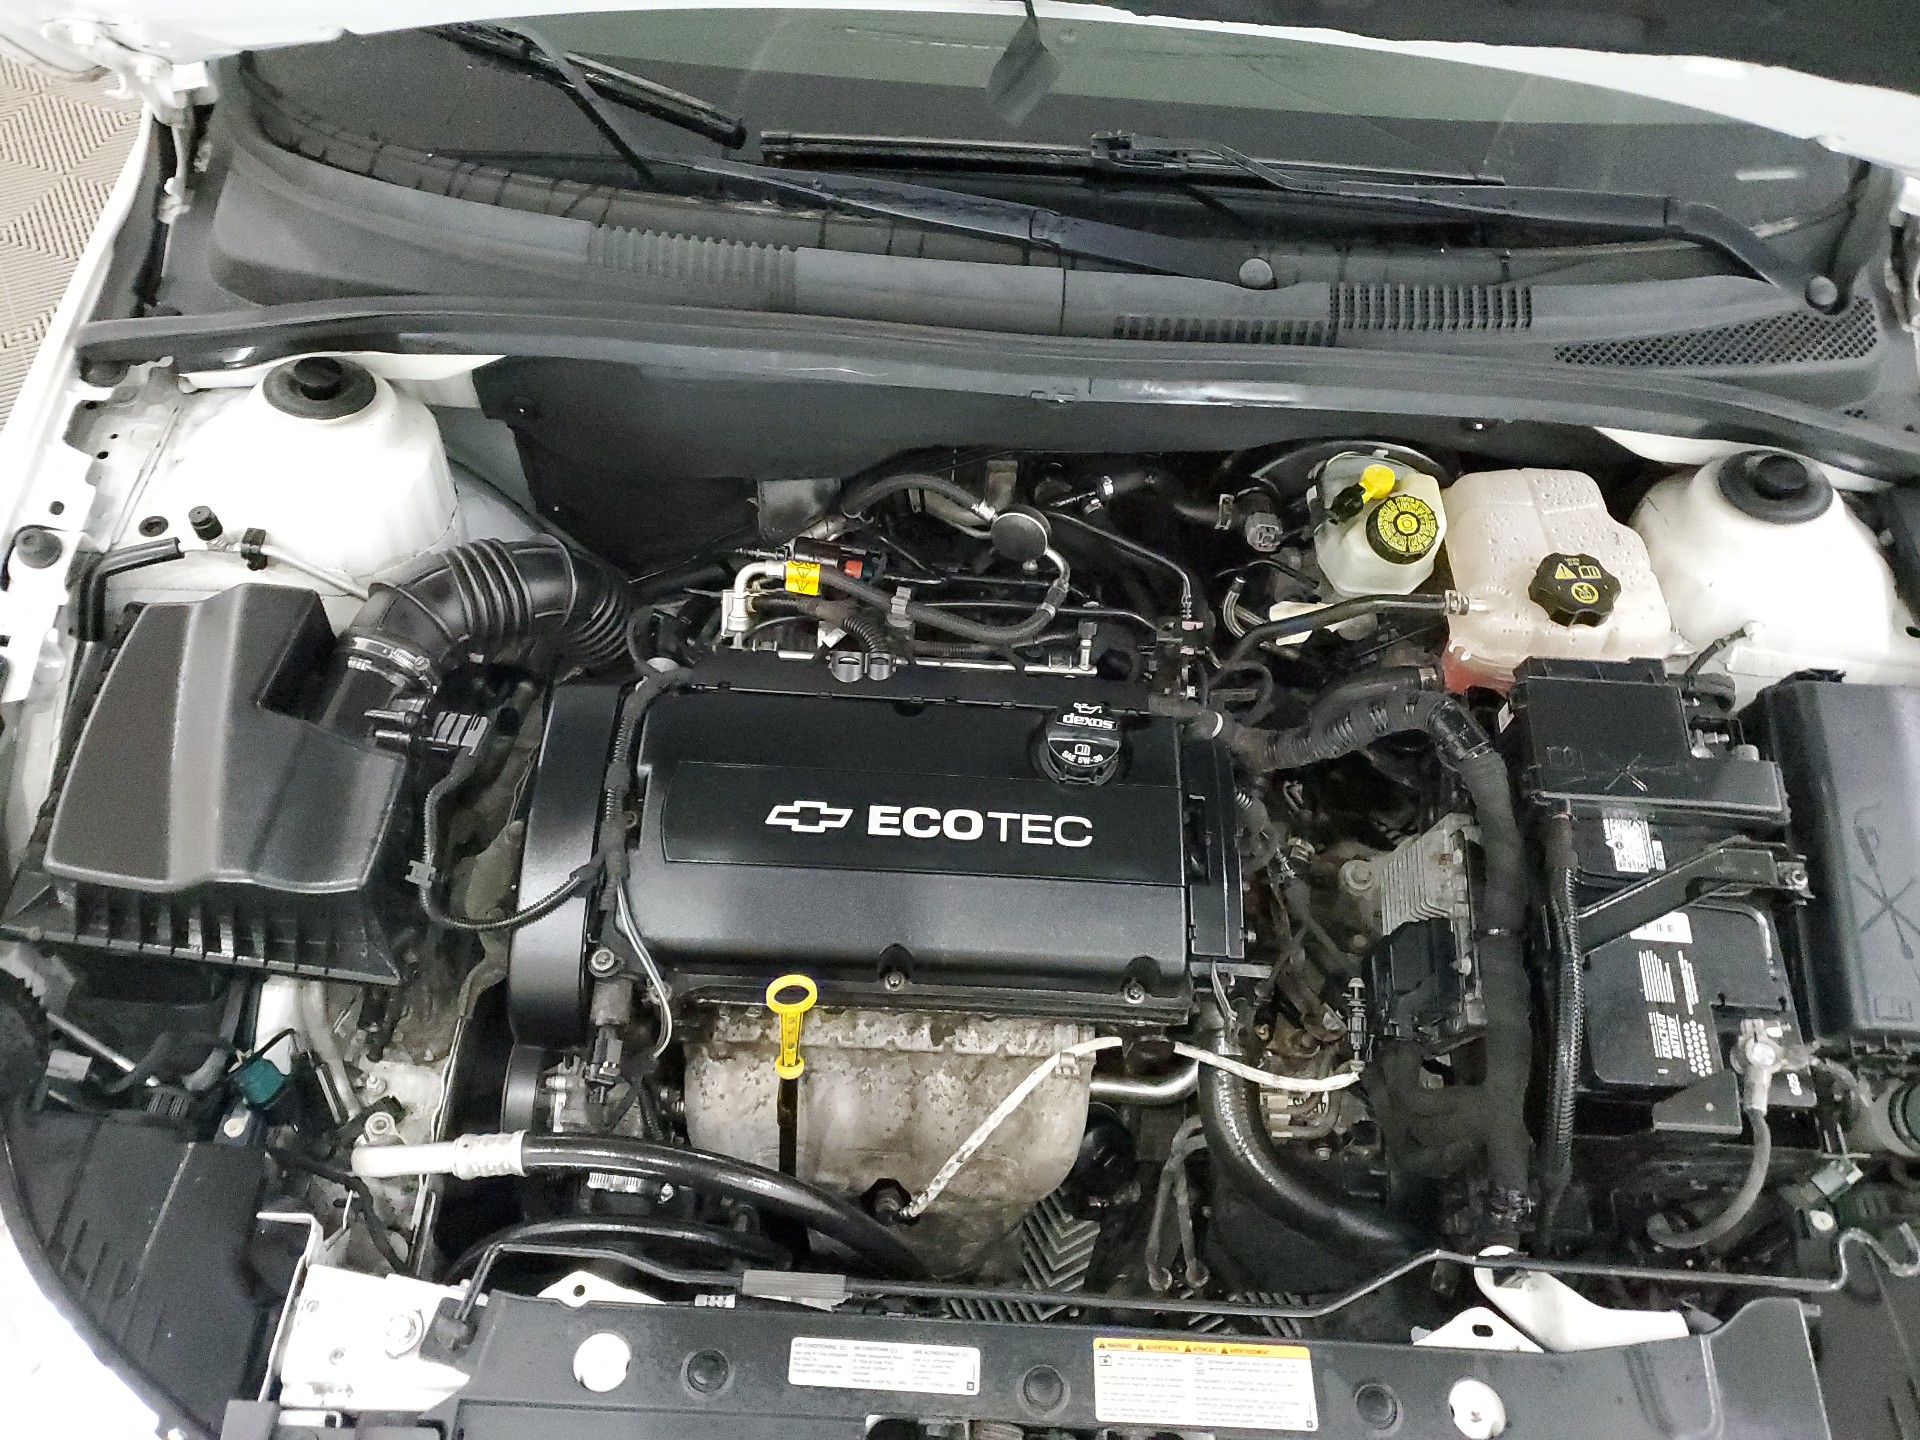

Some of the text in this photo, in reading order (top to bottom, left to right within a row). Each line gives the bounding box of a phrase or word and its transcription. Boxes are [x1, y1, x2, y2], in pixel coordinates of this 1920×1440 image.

[1062, 713, 1115, 729] dexos
[1061, 750, 1104, 765] SAE 5W-30
[867, 804, 1093, 848] ECOTEC
[1666, 1015, 1683, 1059] BATTERY
